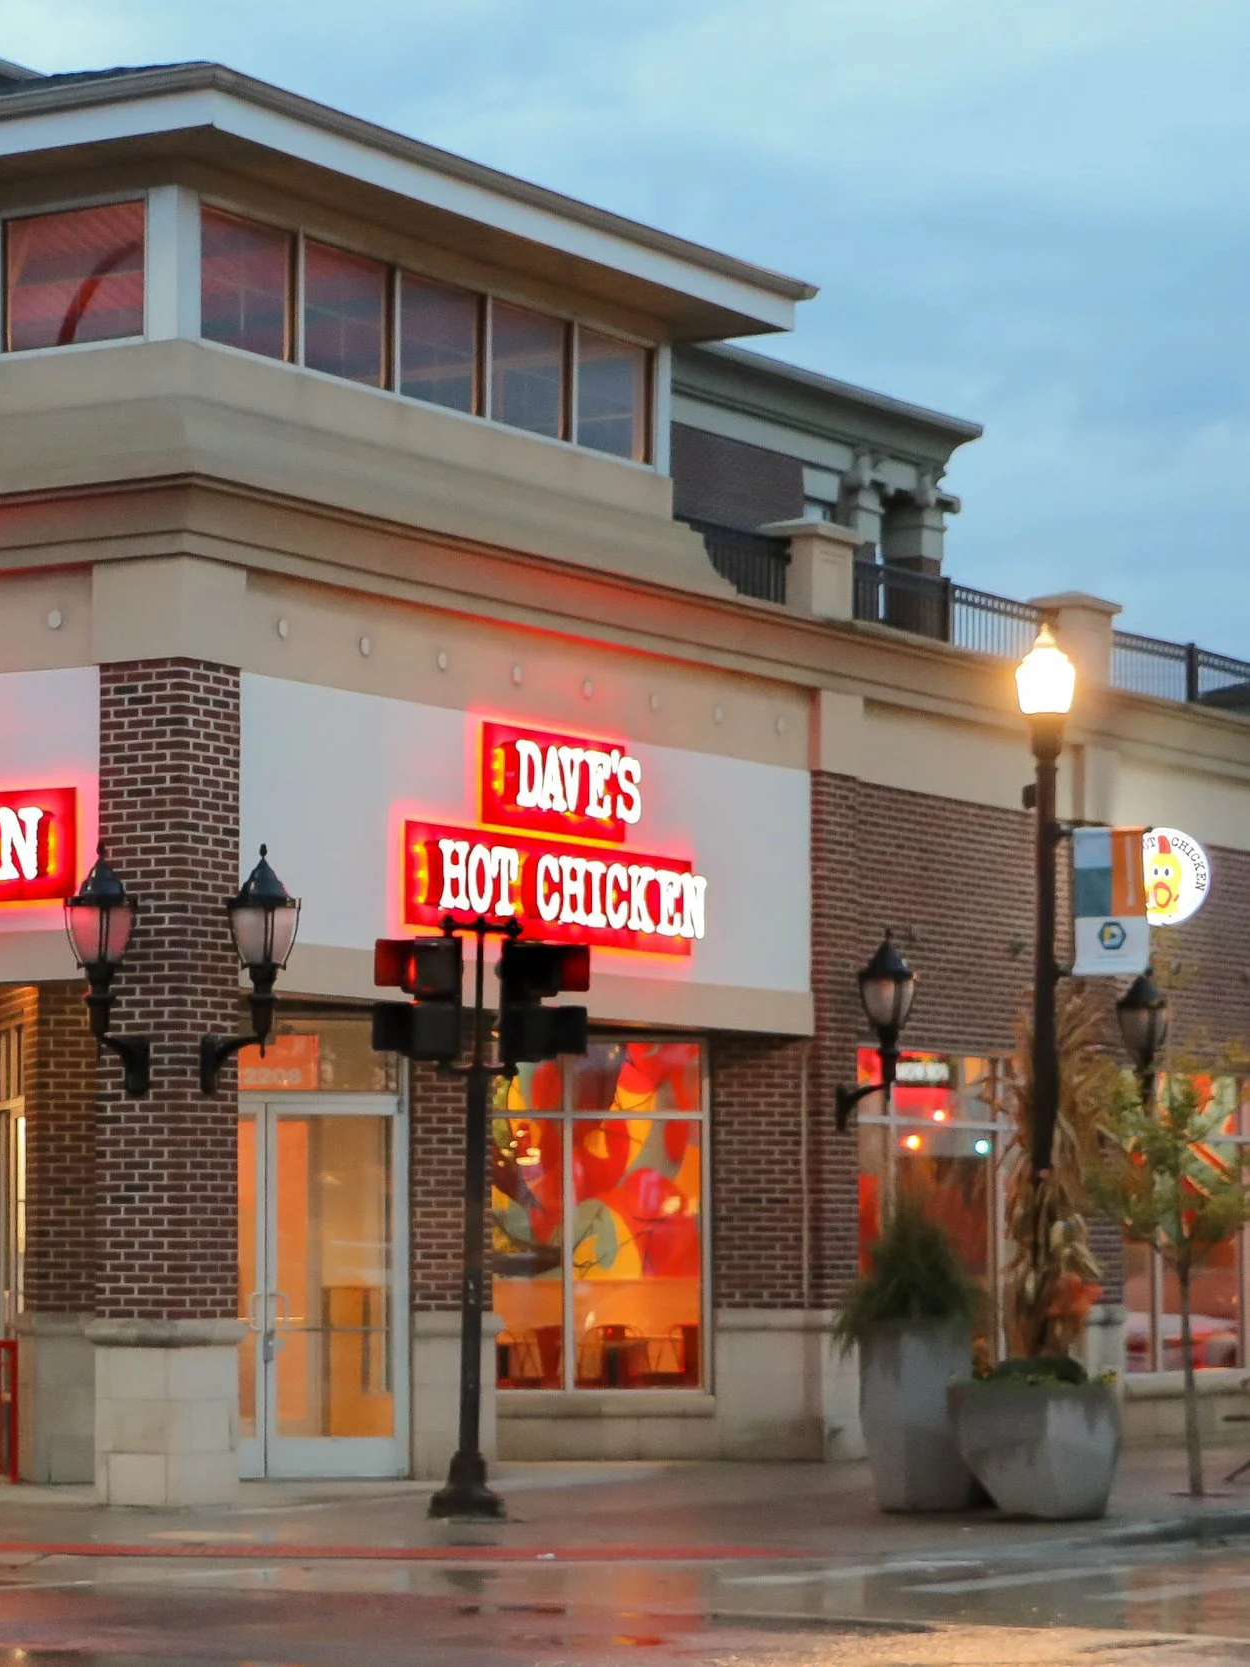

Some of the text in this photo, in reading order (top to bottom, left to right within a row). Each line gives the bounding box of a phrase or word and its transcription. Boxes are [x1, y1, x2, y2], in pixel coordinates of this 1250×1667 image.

[515, 739, 642, 824] DAVE'S
[438, 838, 707, 940] HOT CHICKEN
[1171, 836, 1207, 892] CHICKEN
